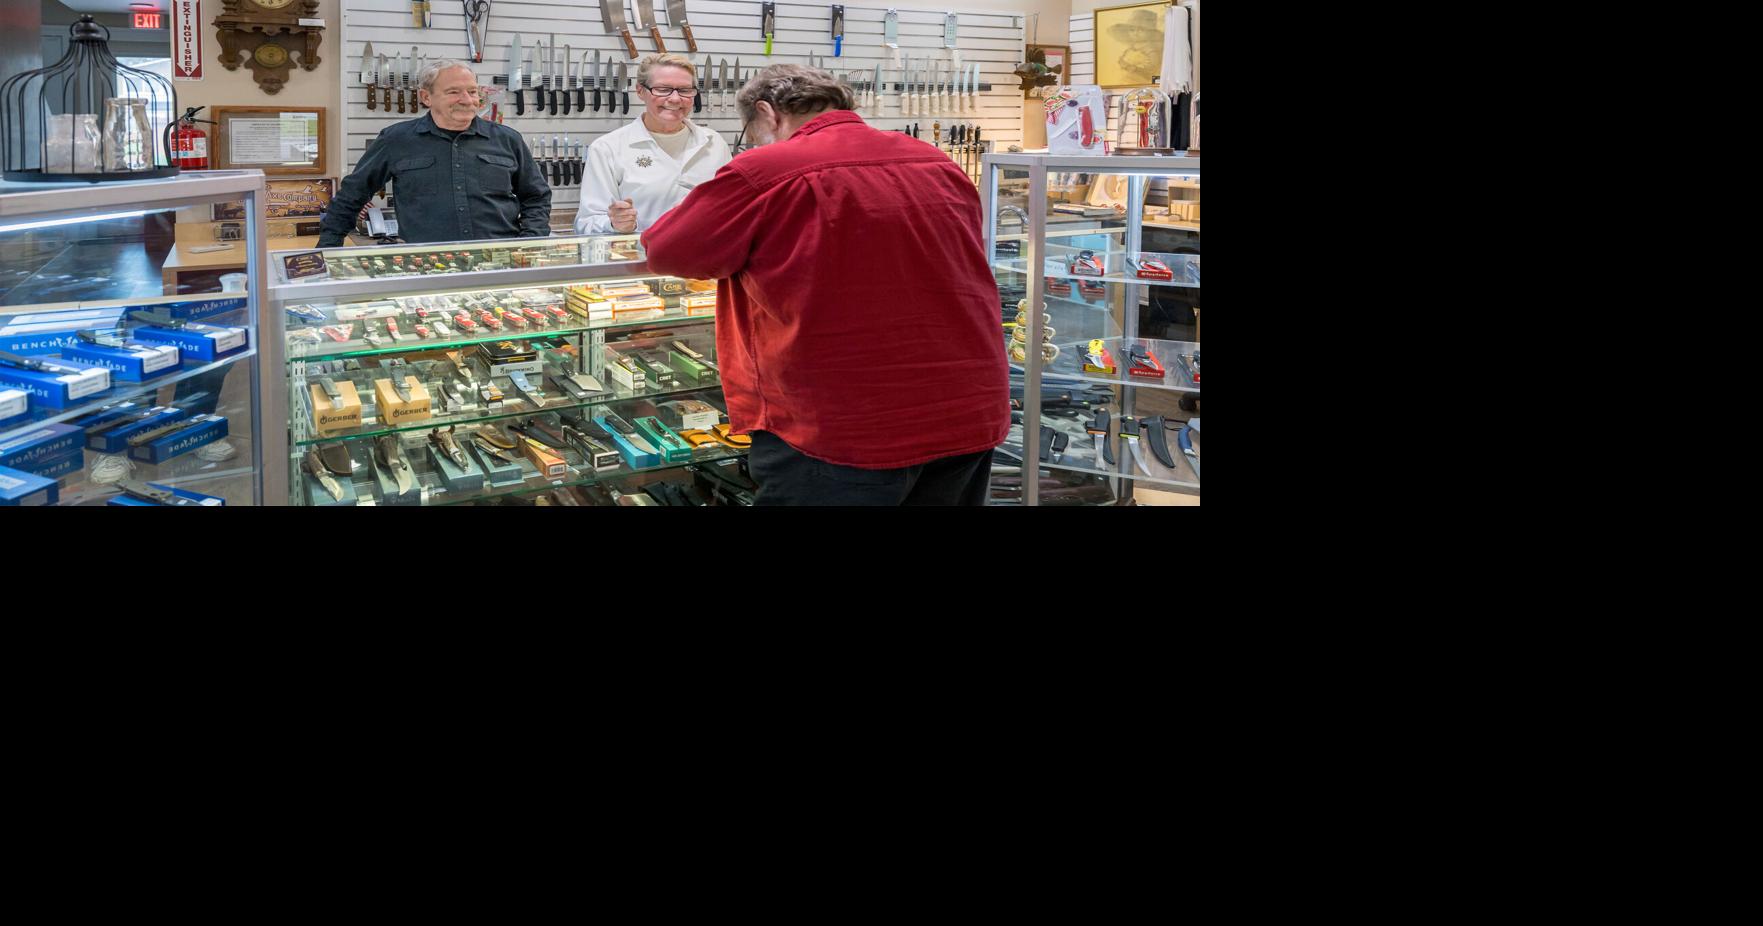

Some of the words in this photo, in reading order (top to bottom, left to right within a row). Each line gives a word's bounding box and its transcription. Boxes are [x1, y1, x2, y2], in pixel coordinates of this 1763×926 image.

[134, 13, 160, 29] EXIT
[183, 1, 192, 72] EXTINGUISHER
[11, 336, 84, 350] BENCHMA
[327, 414, 357, 423] GERBER
[400, 407, 428, 416] GERBER
